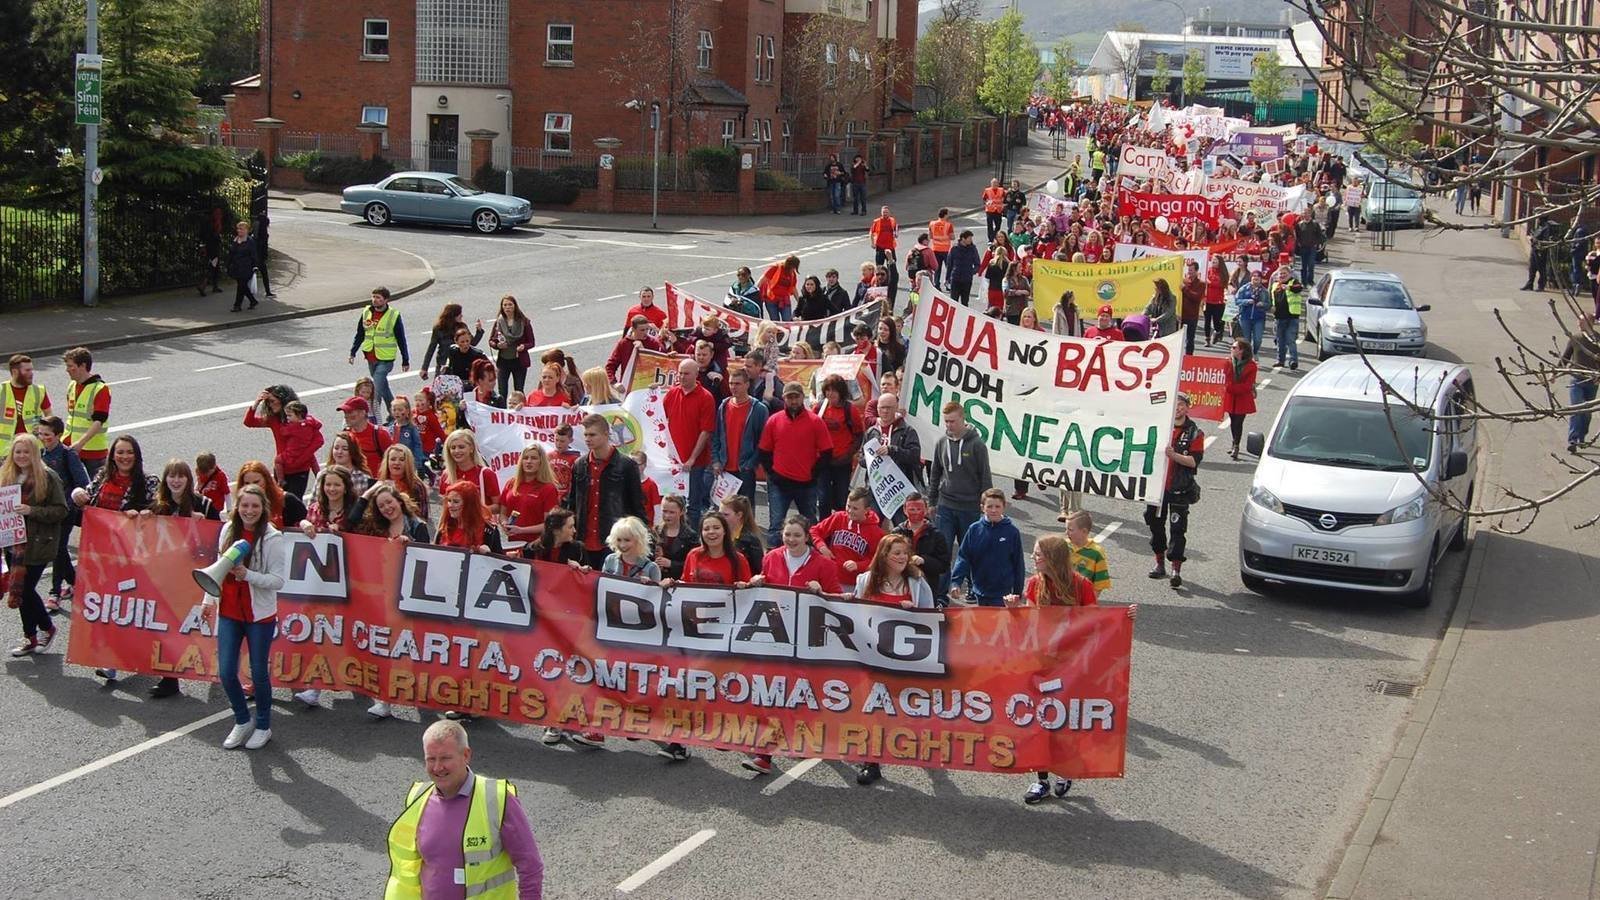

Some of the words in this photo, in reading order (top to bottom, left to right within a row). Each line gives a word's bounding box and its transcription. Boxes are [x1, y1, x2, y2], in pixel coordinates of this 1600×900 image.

[77, 91, 99, 103] Sinn
[78, 103, 99, 116] Féin
[1122, 190, 1182, 216] Teanga
[1186, 200, 1205, 215] na
[925, 296, 998, 370] BUA
[1008, 340, 1049, 368] NÓ
[1054, 340, 1170, 392] BÁS?
[921, 346, 1004, 403] BÍODH
[1180, 367, 1196, 382] aoi
[1197, 367, 1226, 385] bhláth
[908, 372, 1158, 476] MSNEACH
[502, 451, 522, 469] BH
[1021, 462, 1147, 501] AGAINN!
[1298, 547, 1320, 560] KFZ
[1321, 550, 1350, 564] 3524
[410, 559, 527, 615] LÁ
[604, 589, 933, 662] DEARG
[83, 578, 168, 632] SIÚIL
[179, 604, 219, 637] A
[272, 612, 344, 645] ON
[351, 619, 520, 681] CEARTA,
[532, 647, 851, 712] COMTHROMAS
[862, 682, 992, 722] AGUS
[1004, 678, 1115, 731] CÓIR
[151, 640, 381, 695] LAUAGE
[388, 669, 547, 720] RIGHTS
[559, 694, 651, 734] ARE
[663, 704, 825, 752] HUMAN
[838, 722, 1017, 769] RIGHTS
